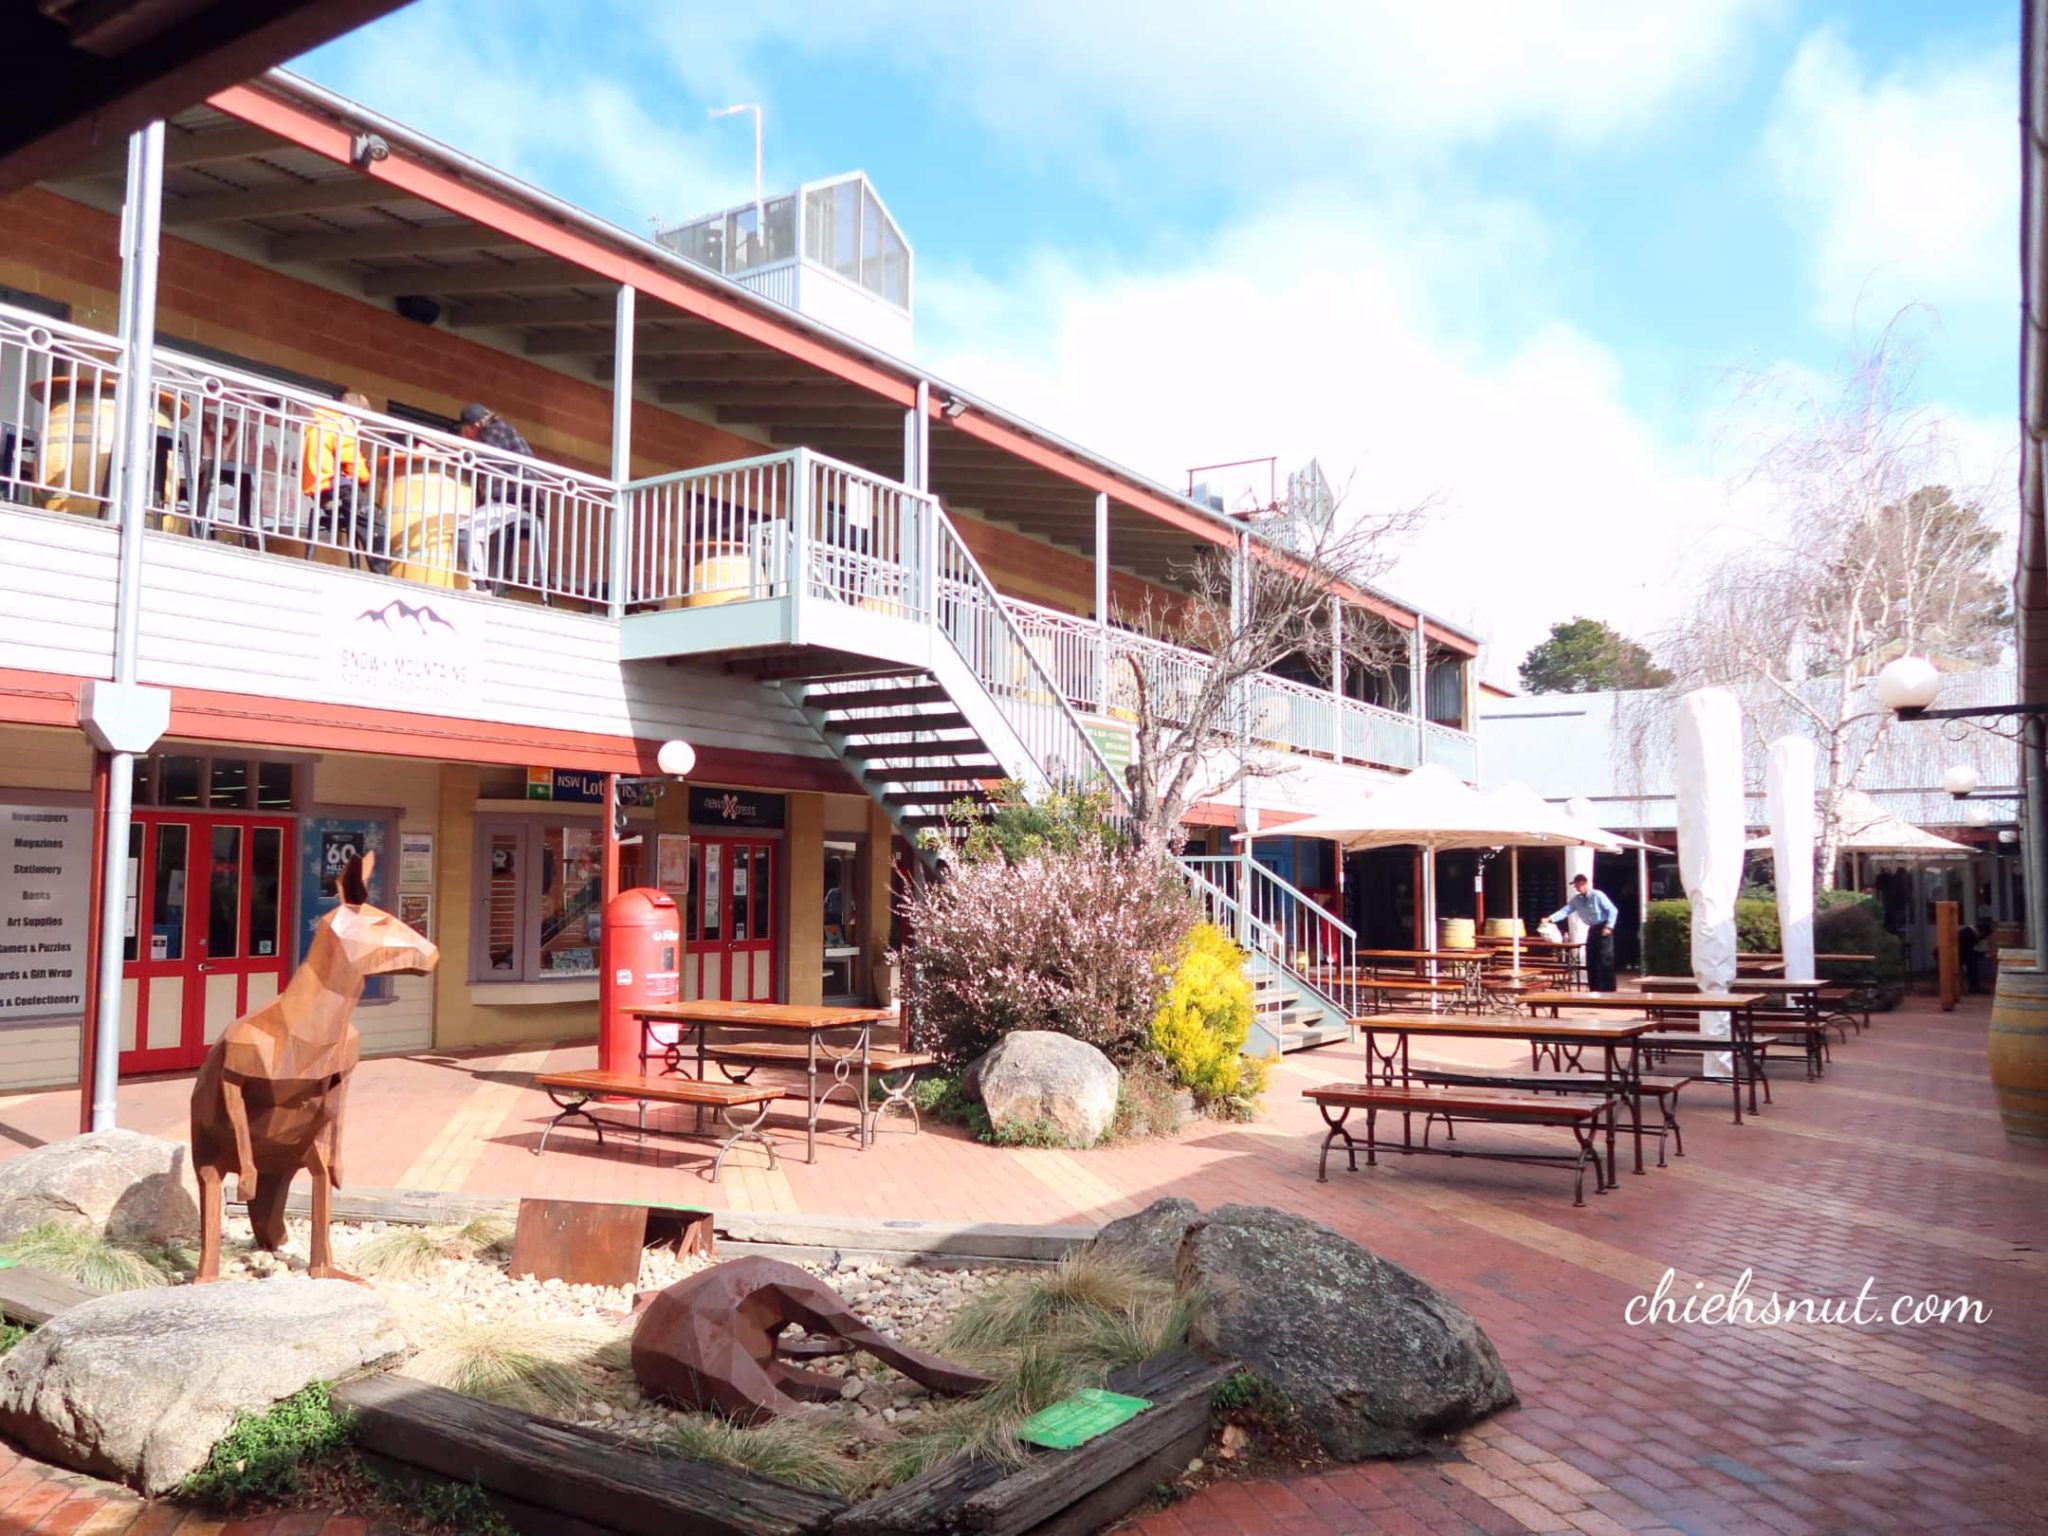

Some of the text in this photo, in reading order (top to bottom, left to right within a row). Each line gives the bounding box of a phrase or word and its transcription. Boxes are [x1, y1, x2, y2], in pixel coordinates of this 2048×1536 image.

[342, 649, 467, 683] SNOW MOUNTANS
[557, 775, 580, 788] NSW
[14, 838, 64, 849] Magazines
[14, 864, 62, 875] Stationery
[22, 891, 51, 901] Books
[7, 917, 63, 927] Art Supplies
[38, 943, 72, 953] Puzzles
[0, 971, 20, 980] ards
[30, 969, 47, 979] Gift
[48, 969, 73, 978] Wrap
[14, 995, 80, 1007] Confectionery
